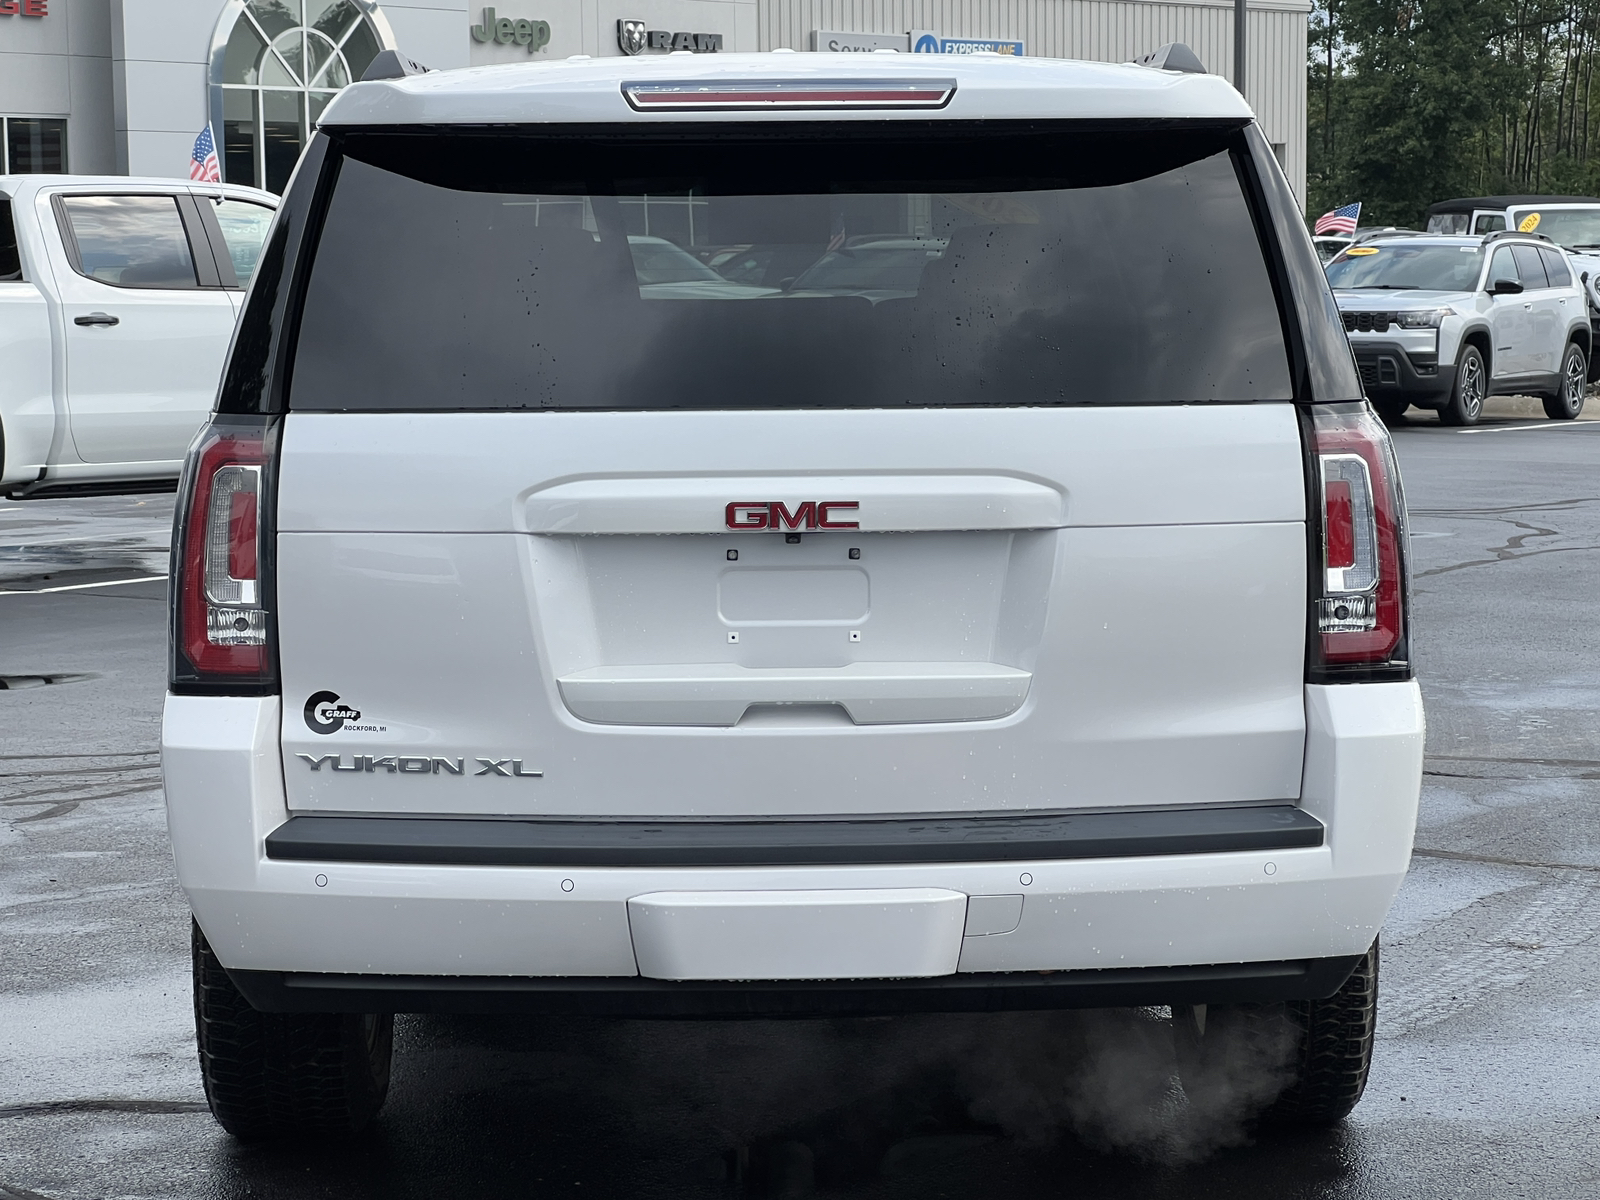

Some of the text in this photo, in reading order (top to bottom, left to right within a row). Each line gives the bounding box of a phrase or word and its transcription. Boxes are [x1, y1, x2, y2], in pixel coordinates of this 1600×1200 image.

[471, 7, 550, 54] Jeep
[647, 31, 723, 51] RAM
[725, 500, 860, 531] GMC
[325, 710, 357, 718] GRAFF
[344, 725, 378, 733] ROCKFORD,
[294, 752, 544, 778] YUKON XL
